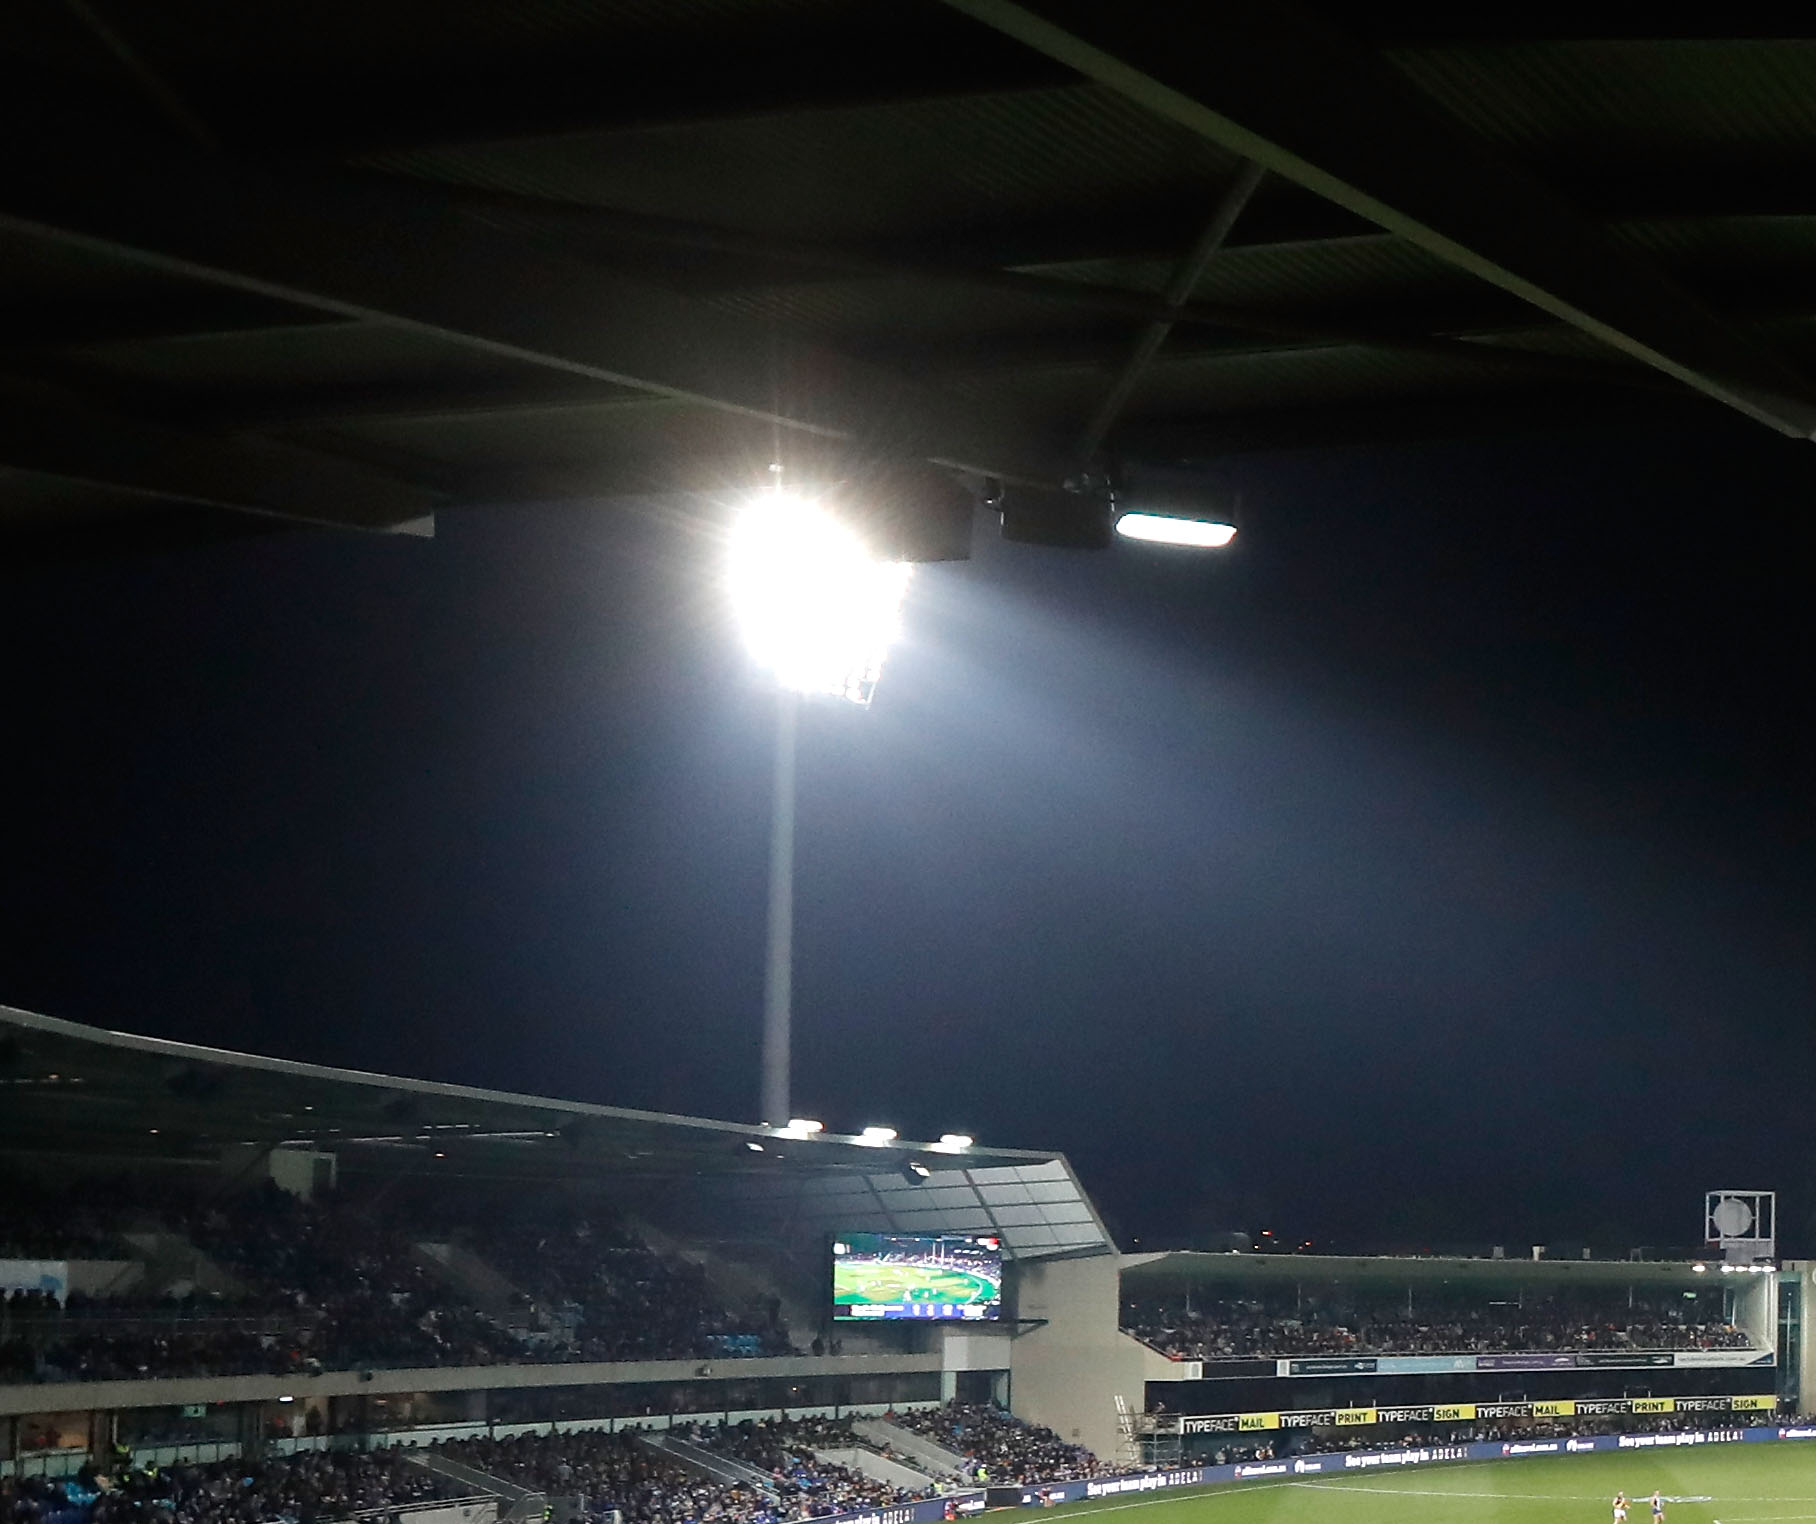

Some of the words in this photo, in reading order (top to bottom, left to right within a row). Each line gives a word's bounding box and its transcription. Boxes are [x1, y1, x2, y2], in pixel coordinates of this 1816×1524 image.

[1476, 1404, 1528, 1418] TYPEFACE
[1534, 1404, 1560, 1416] MAIL
[1576, 1401, 1627, 1415] TYPEFACE
[1634, 1401, 1665, 1412] PRINT
[1675, 1399, 1726, 1412] TYPEFACE
[1733, 1399, 1758, 1410] SIGN
[1280, 1412, 1331, 1428] TYPEFACE
[1337, 1411, 1368, 1424] PRINT
[1378, 1407, 1429, 1422] TYPEFACE
[1435, 1407, 1460, 1420] SIGN
[1184, 1417, 1235, 1433] TYPEFACE
[1241, 1418, 1265, 1429] MAIL
